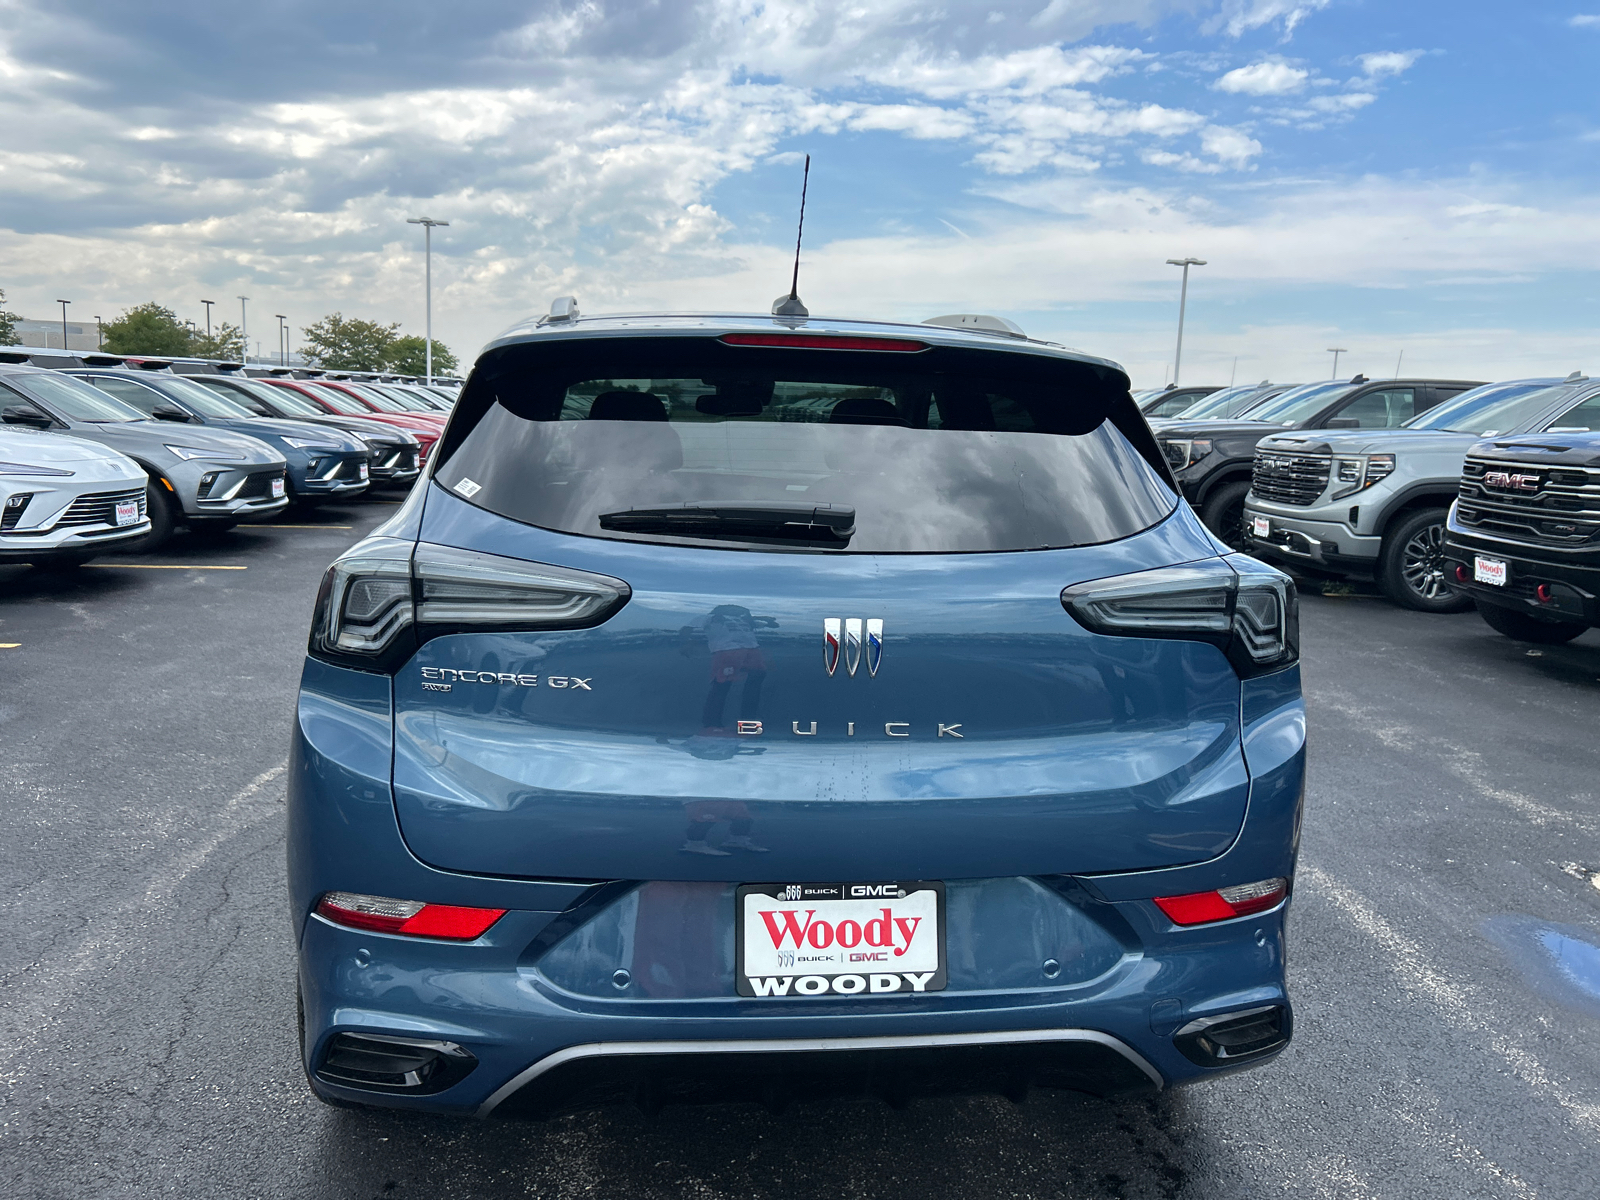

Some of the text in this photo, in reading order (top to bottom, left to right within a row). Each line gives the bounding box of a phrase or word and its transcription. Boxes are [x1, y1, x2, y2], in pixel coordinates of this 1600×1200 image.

[1485, 471, 1540, 491] GMC
[117, 505, 137, 516] Woody
[1478, 560, 1504, 577] Woody
[421, 666, 593, 691] ENCORE GX
[421, 682, 452, 692] AWD
[737, 720, 964, 738] BUICK
[850, 884, 898, 896] GMC
[757, 908, 923, 957] Woody
[849, 952, 888, 962] GMC
[748, 972, 936, 997] WOODY
